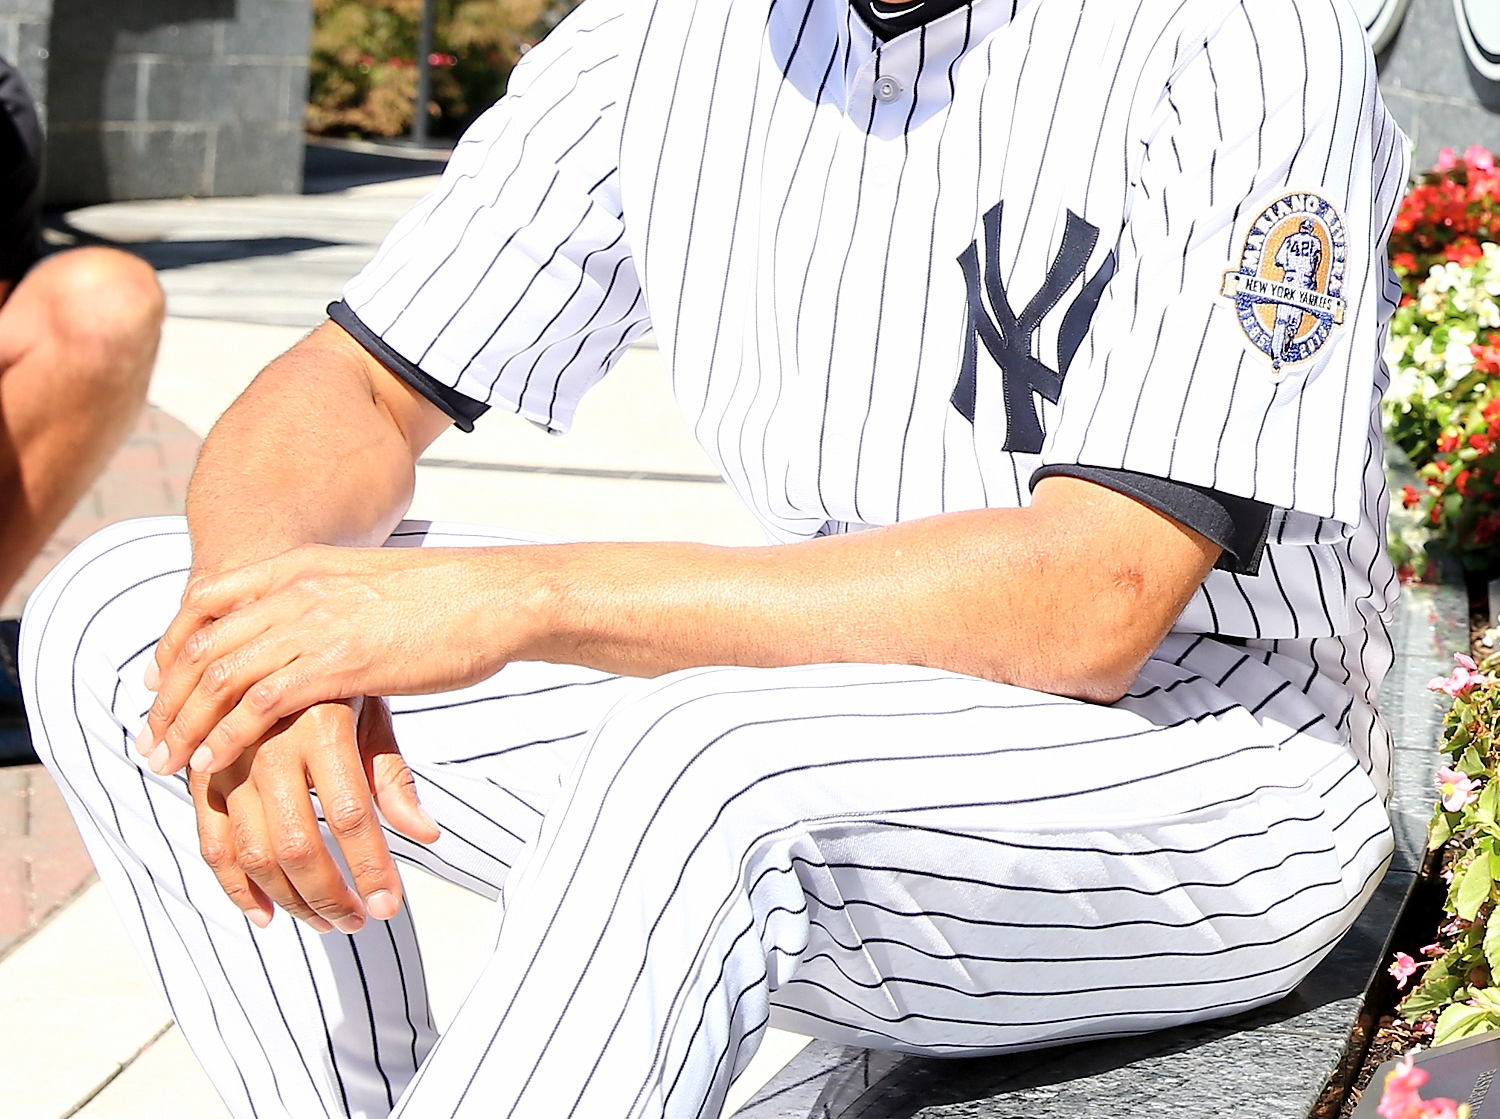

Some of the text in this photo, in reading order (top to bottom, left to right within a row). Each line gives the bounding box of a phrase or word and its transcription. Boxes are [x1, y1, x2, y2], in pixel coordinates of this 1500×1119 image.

[1242, 193, 1320, 273] MARIANO
[1290, 240, 1310, 256] 42
[1245, 278, 1333, 310] NEW YORK YANKEES
[950, 199, 1116, 454] NY
[1299, 326, 1329, 359] 2013
